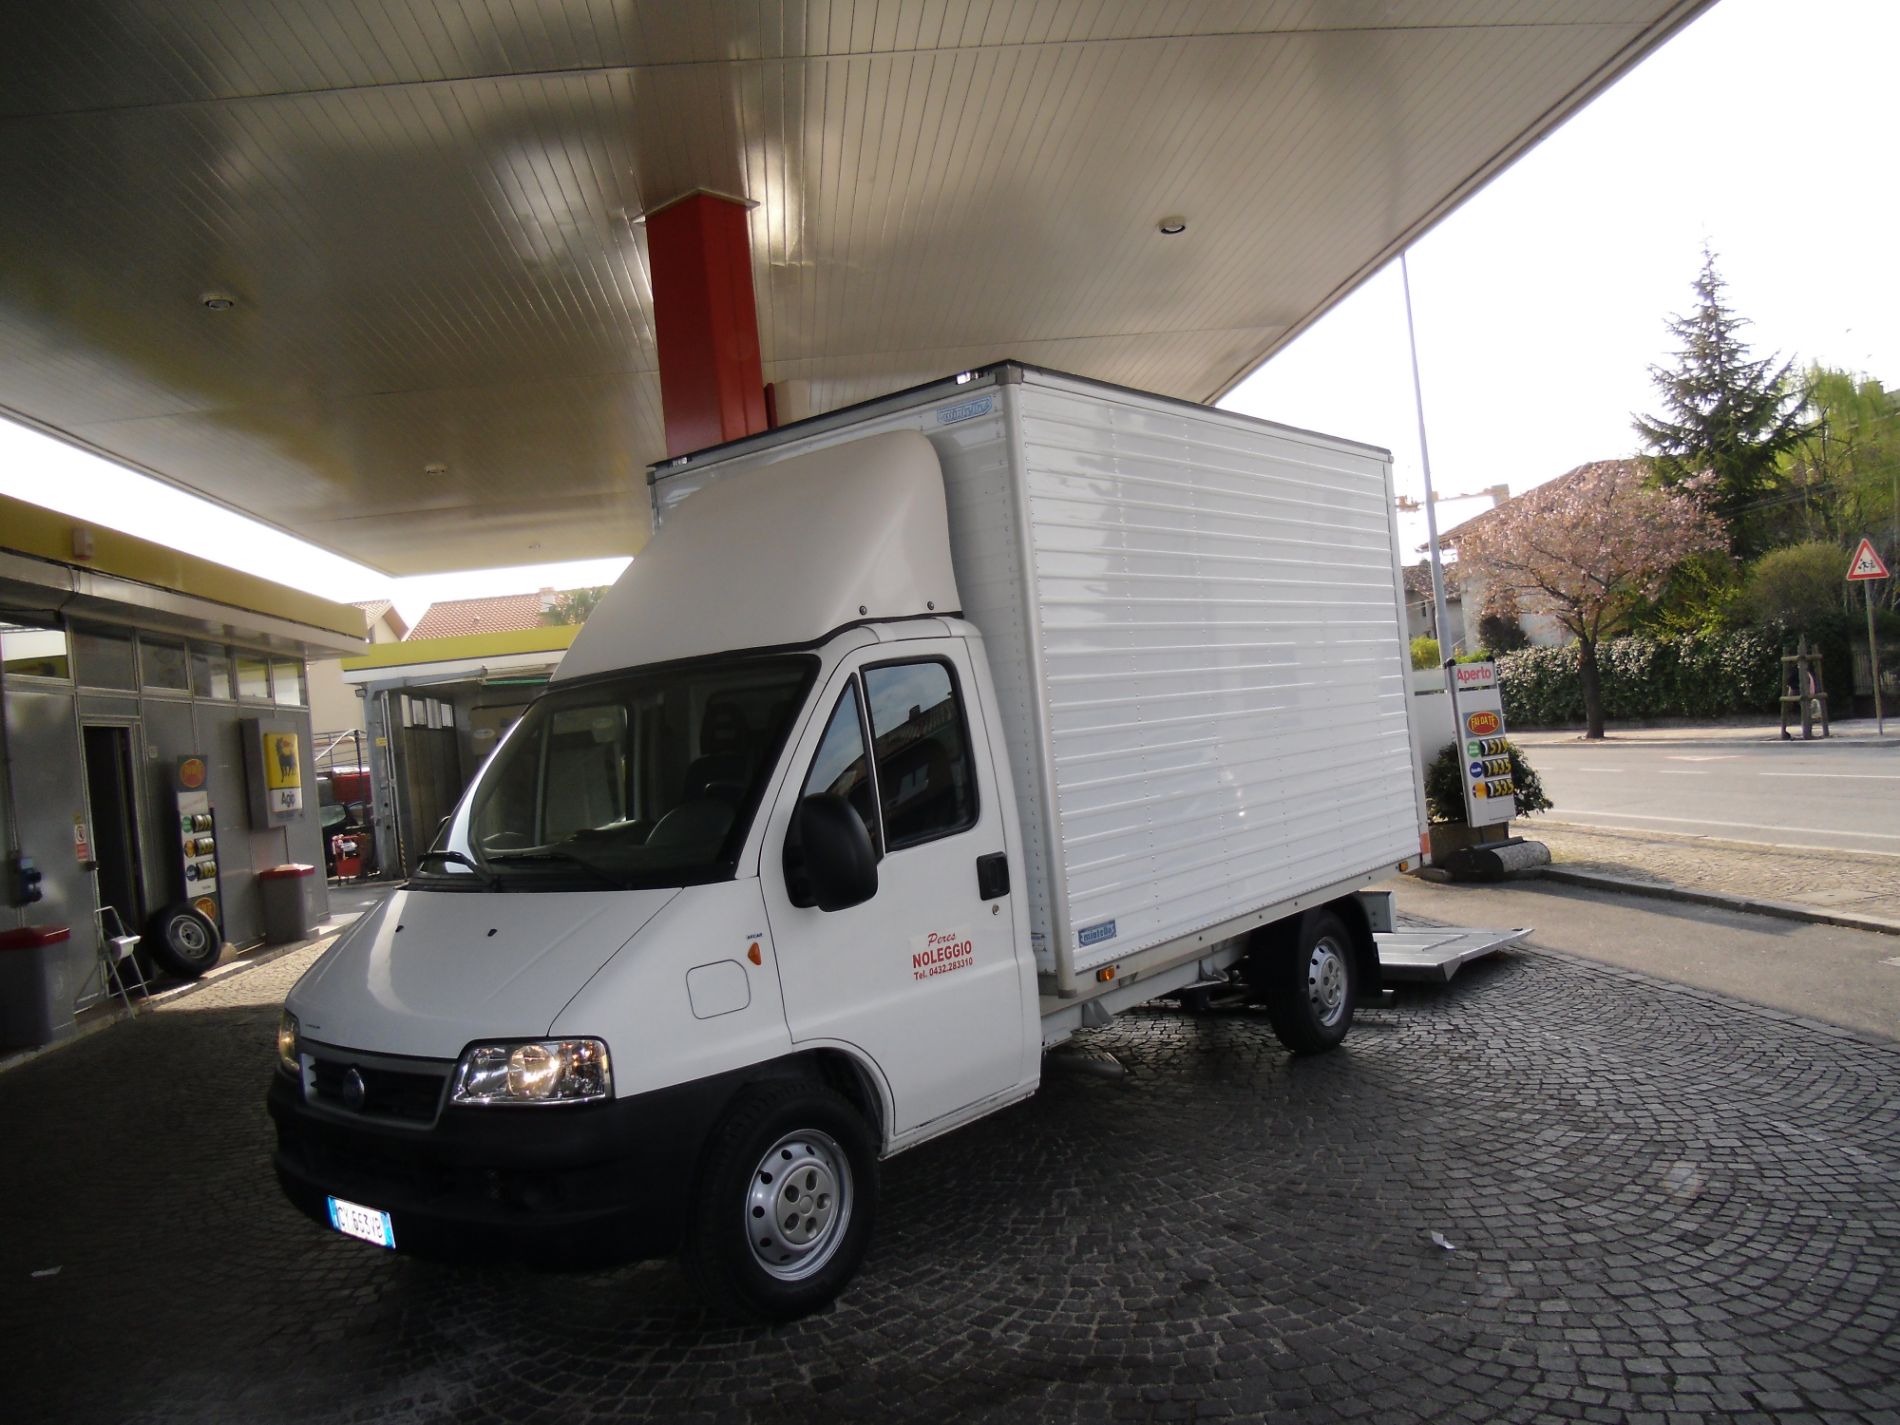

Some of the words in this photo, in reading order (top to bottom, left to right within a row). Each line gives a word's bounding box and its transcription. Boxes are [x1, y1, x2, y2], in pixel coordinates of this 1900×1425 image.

[1457, 667, 1491, 684] Aperto
[928, 932, 956, 947] Peres
[912, 940, 972, 968] NOLEGGIO
[914, 970, 927, 980] Tel.
[929, 957, 973, 976] 0432.283310
